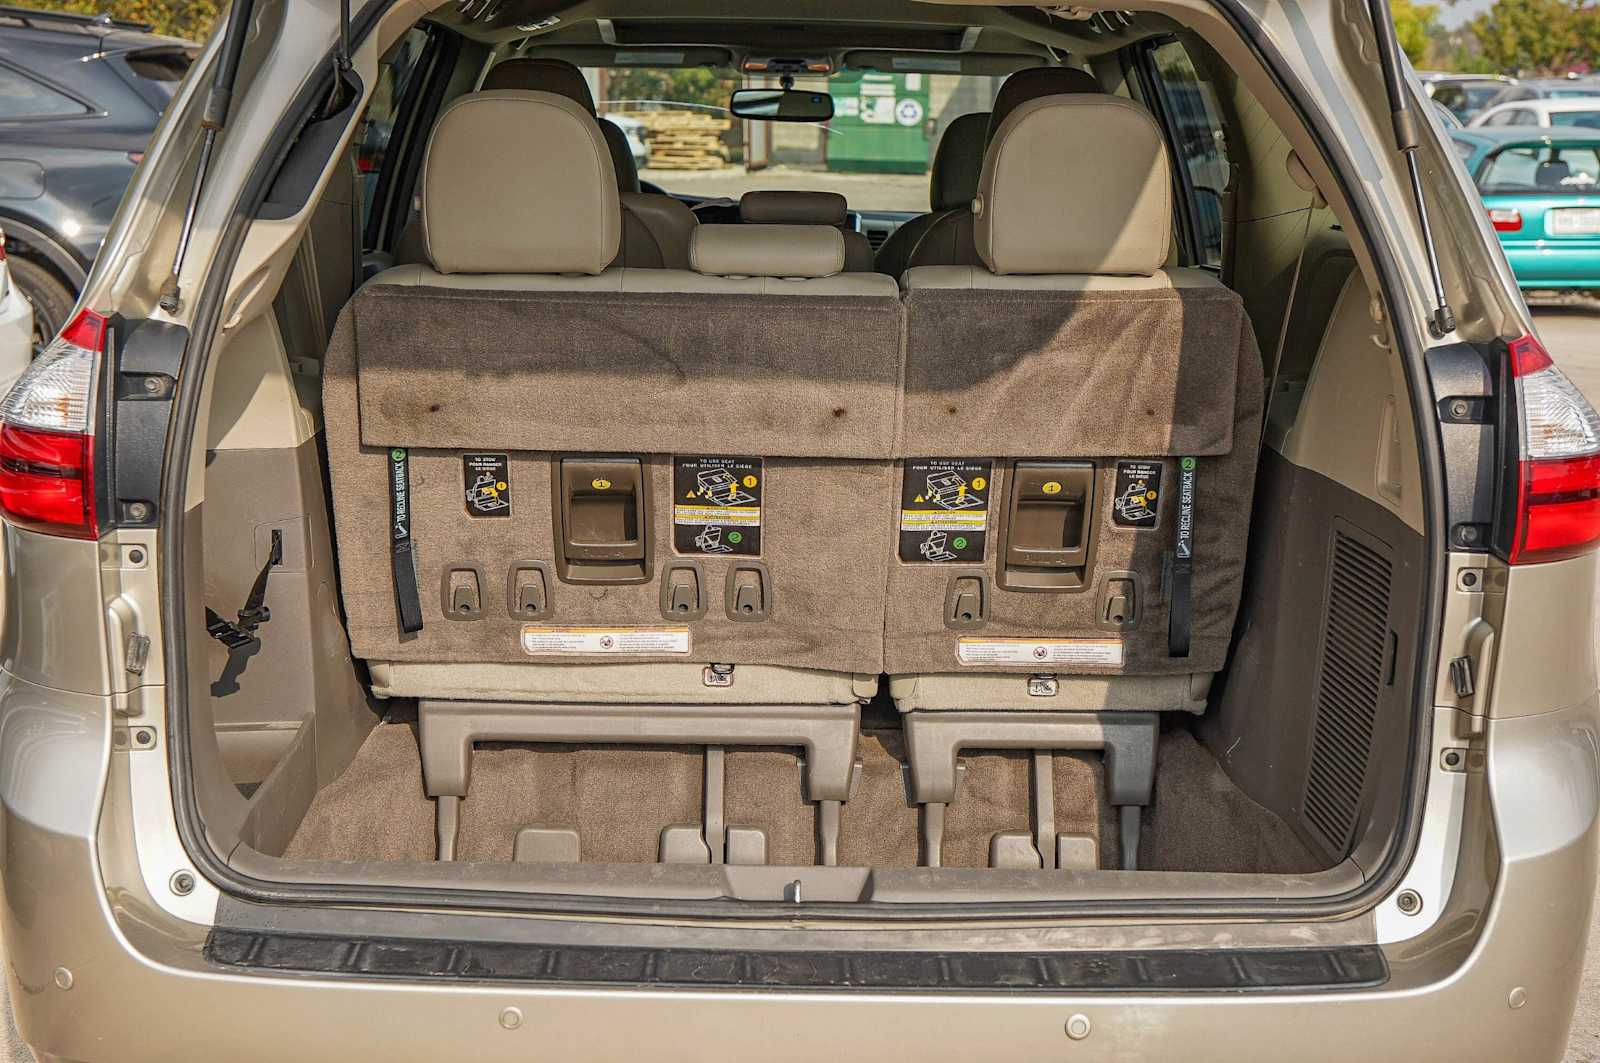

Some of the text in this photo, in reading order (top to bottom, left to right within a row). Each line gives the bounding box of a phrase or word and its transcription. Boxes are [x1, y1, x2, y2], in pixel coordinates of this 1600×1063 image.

[394, 461, 406, 523] TO RECLINE SEATBACK
[1180, 471, 1193, 539] TO RECLINE SEATBACK
